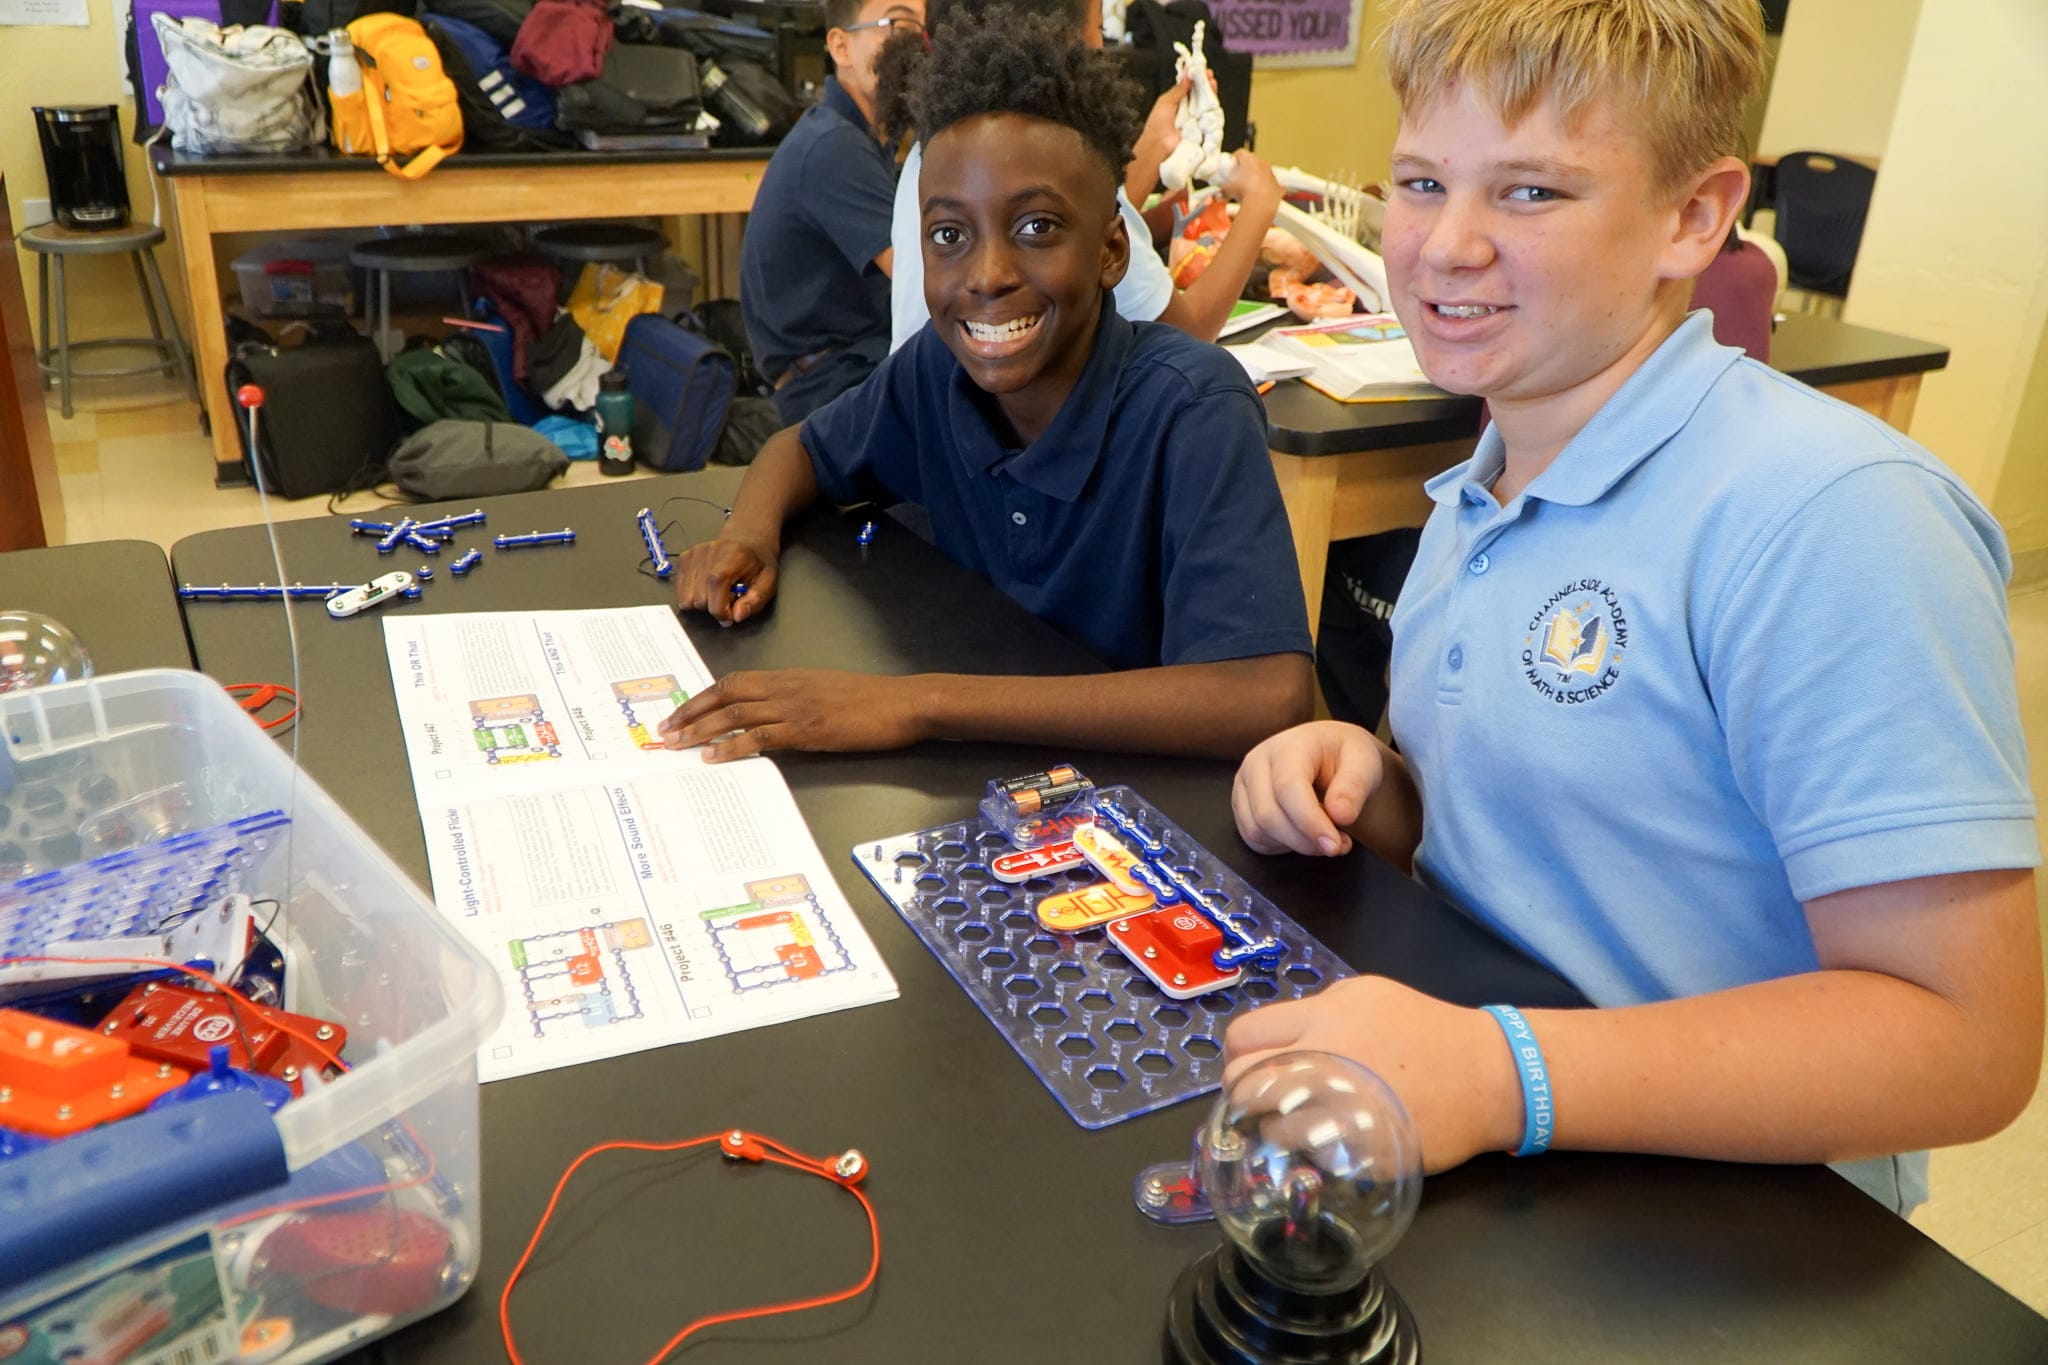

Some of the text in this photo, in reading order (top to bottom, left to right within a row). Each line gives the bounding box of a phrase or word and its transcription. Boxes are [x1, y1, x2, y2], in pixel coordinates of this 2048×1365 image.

[1600, 587, 1628, 649] ACADEMY
[408, 640, 425, 688] This OR That
[1522, 649, 1534, 667] OF
[1526, 668, 1555, 700] MATH
[1567, 665, 1620, 704] SCIENCE
[431, 734, 444, 755] Project
[579, 720, 596, 742] Project
[612, 786, 653, 880] More Sound Effects
[450, 832, 480, 918] Light-Controlled
[659, 923, 694, 983] Project #46
[1500, 1005, 1551, 1147] APPY BIRTHDAY
